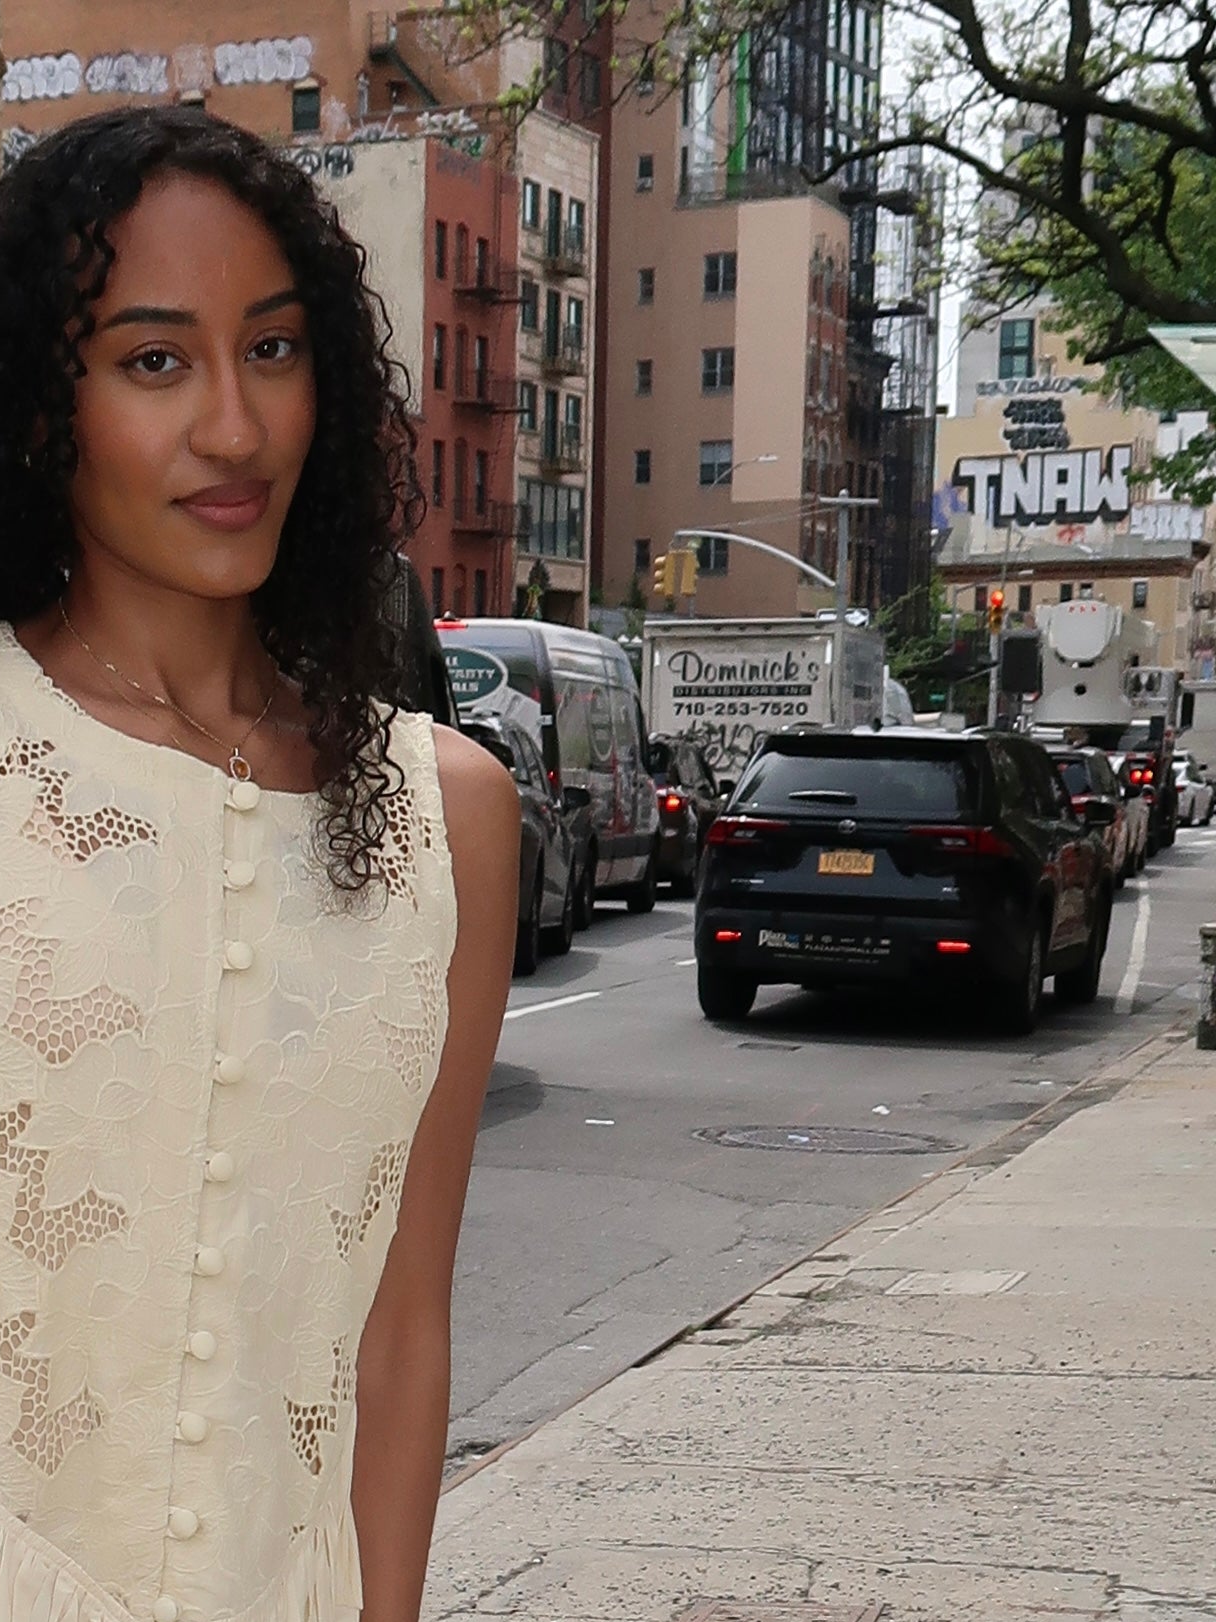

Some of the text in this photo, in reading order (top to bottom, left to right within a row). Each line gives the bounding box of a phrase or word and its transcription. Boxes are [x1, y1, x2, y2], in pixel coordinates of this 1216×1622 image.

[668, 650, 820, 683] Dominick's
[675, 686, 778, 696] DISTRIBUTORS
[673, 702, 809, 716] 718-253-7520
